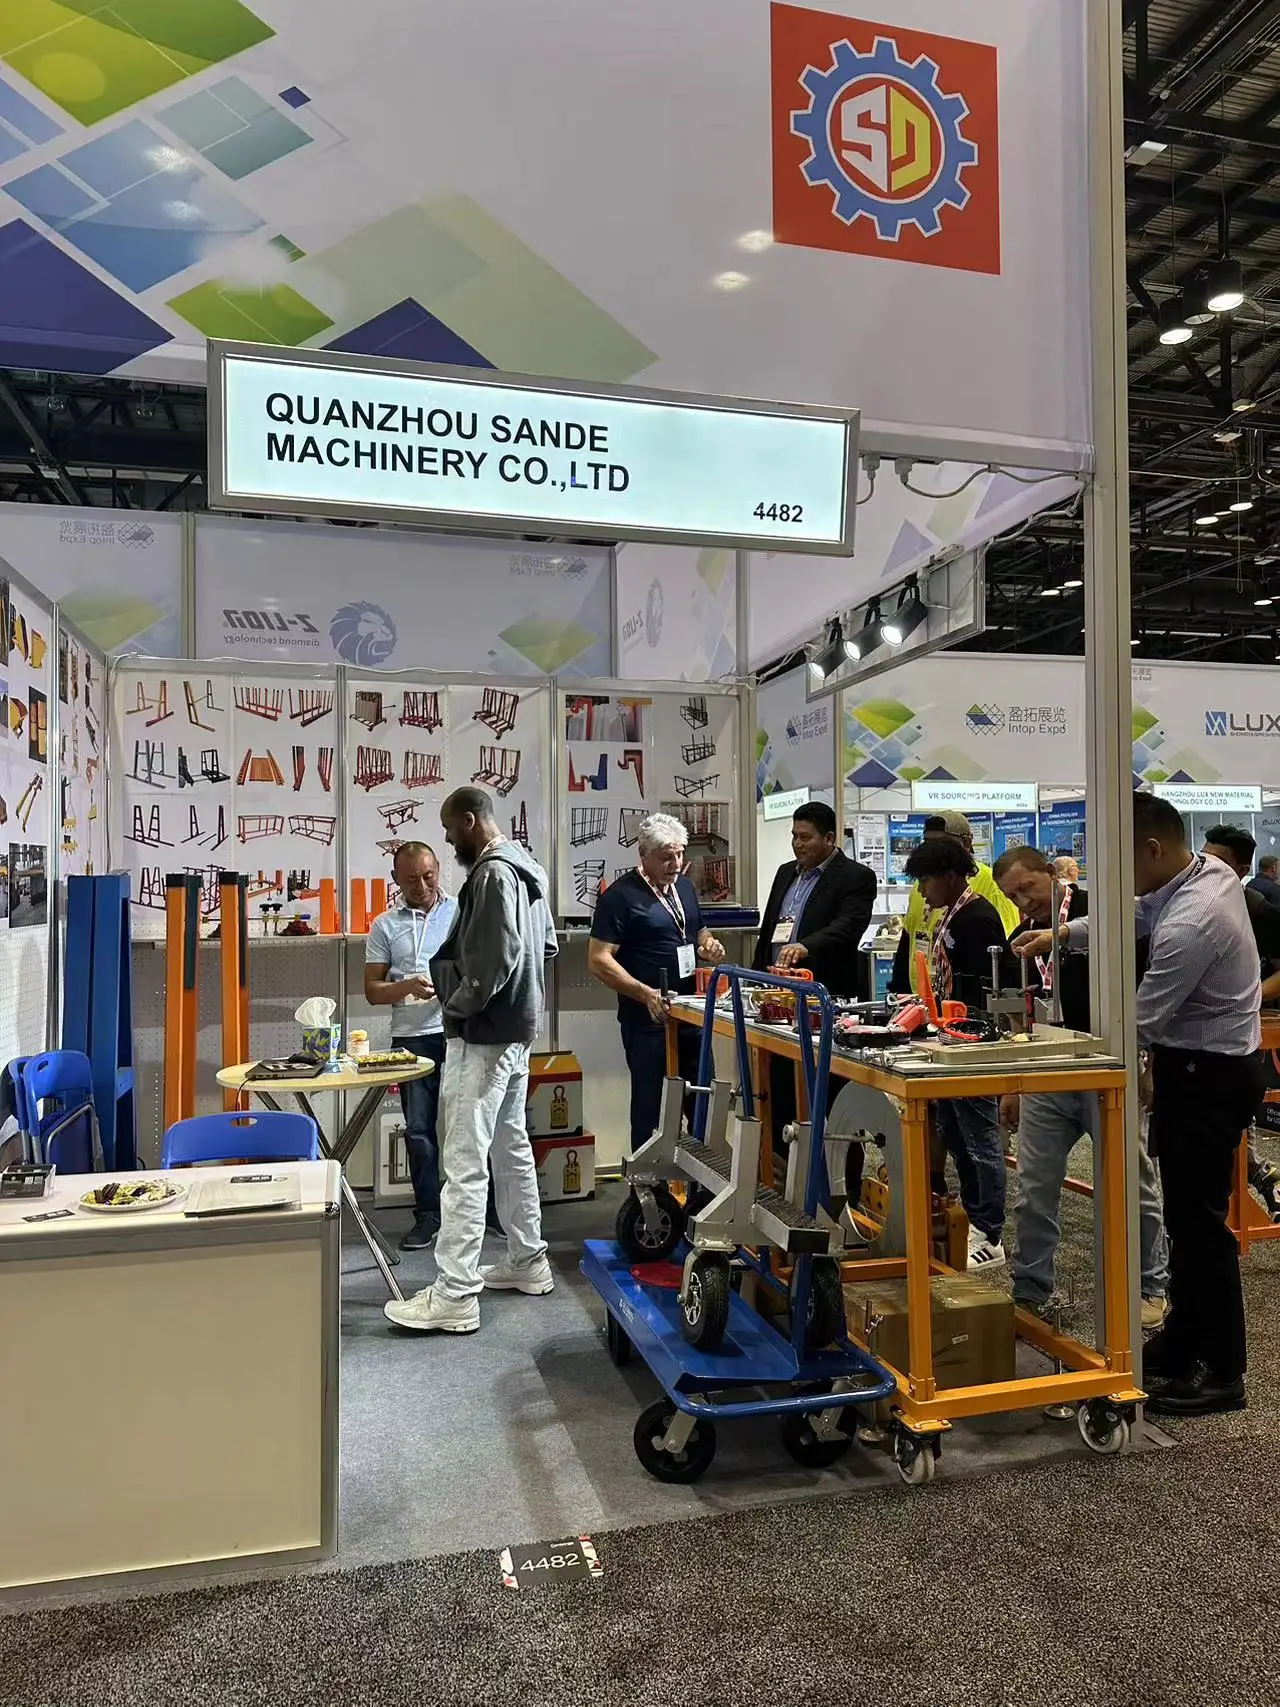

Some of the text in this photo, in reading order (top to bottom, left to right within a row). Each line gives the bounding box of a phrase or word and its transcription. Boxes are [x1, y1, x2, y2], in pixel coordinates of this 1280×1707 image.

[265, 392, 609, 453] QUANZHOU SANDE
[266, 432, 630, 492] MACHINERY CO.,LTD
[753, 502, 804, 523] 4482
[1009, 706, 1067, 722] 盈拓展览
[1229, 713, 1280, 732] LUX
[1008, 723, 1036, 736] Intop
[928, 792, 939, 800] VR
[981, 792, 1022, 800] PLATFORM
[1161, 790, 1196, 798] HANGZHOU
[1224, 791, 1255, 799] MATERIAL
[519, 1552, 581, 1572] 4482
